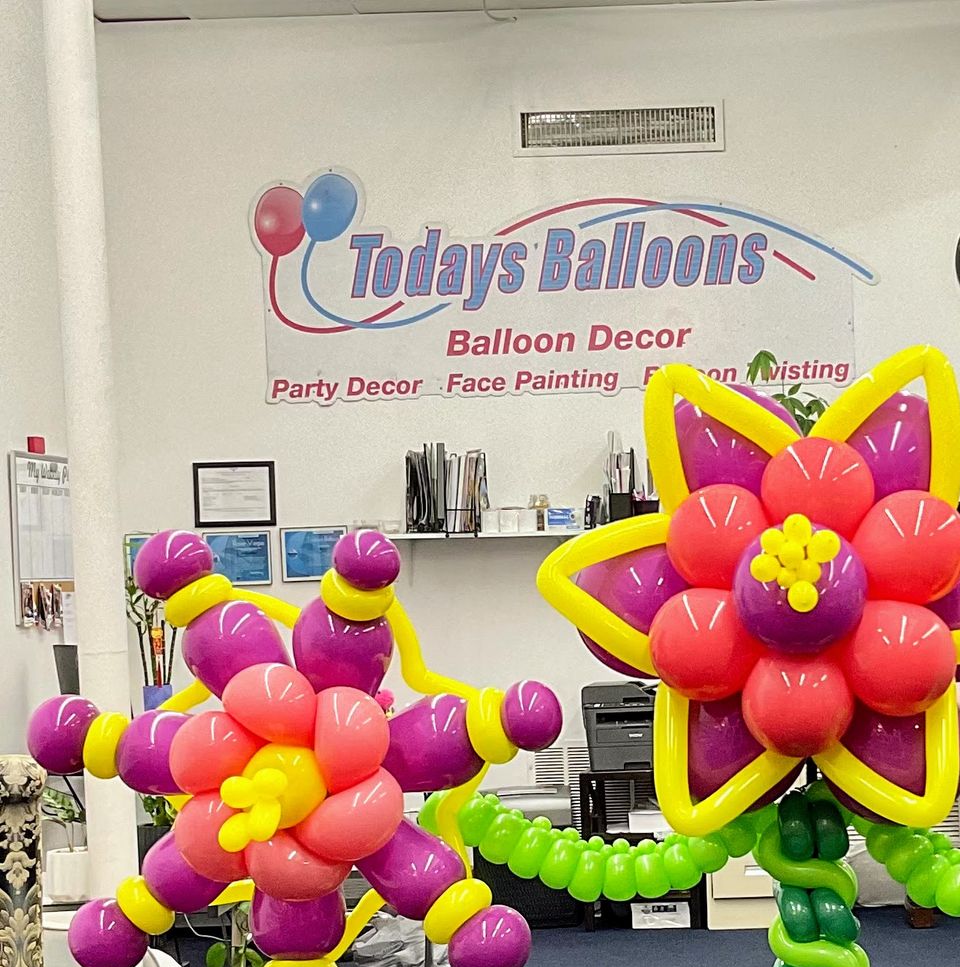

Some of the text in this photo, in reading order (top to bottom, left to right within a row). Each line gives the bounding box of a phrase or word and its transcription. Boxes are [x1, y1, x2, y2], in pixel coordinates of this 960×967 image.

[349, 221, 768, 311] Todays Balloons
[446, 324, 692, 357] Balloon Decor
[271, 378, 339, 401] Party
[346, 376, 424, 397] Decor
[446, 373, 506, 393] Face
[514, 369, 619, 392] Painting
[746, 359, 850, 383] wisting
